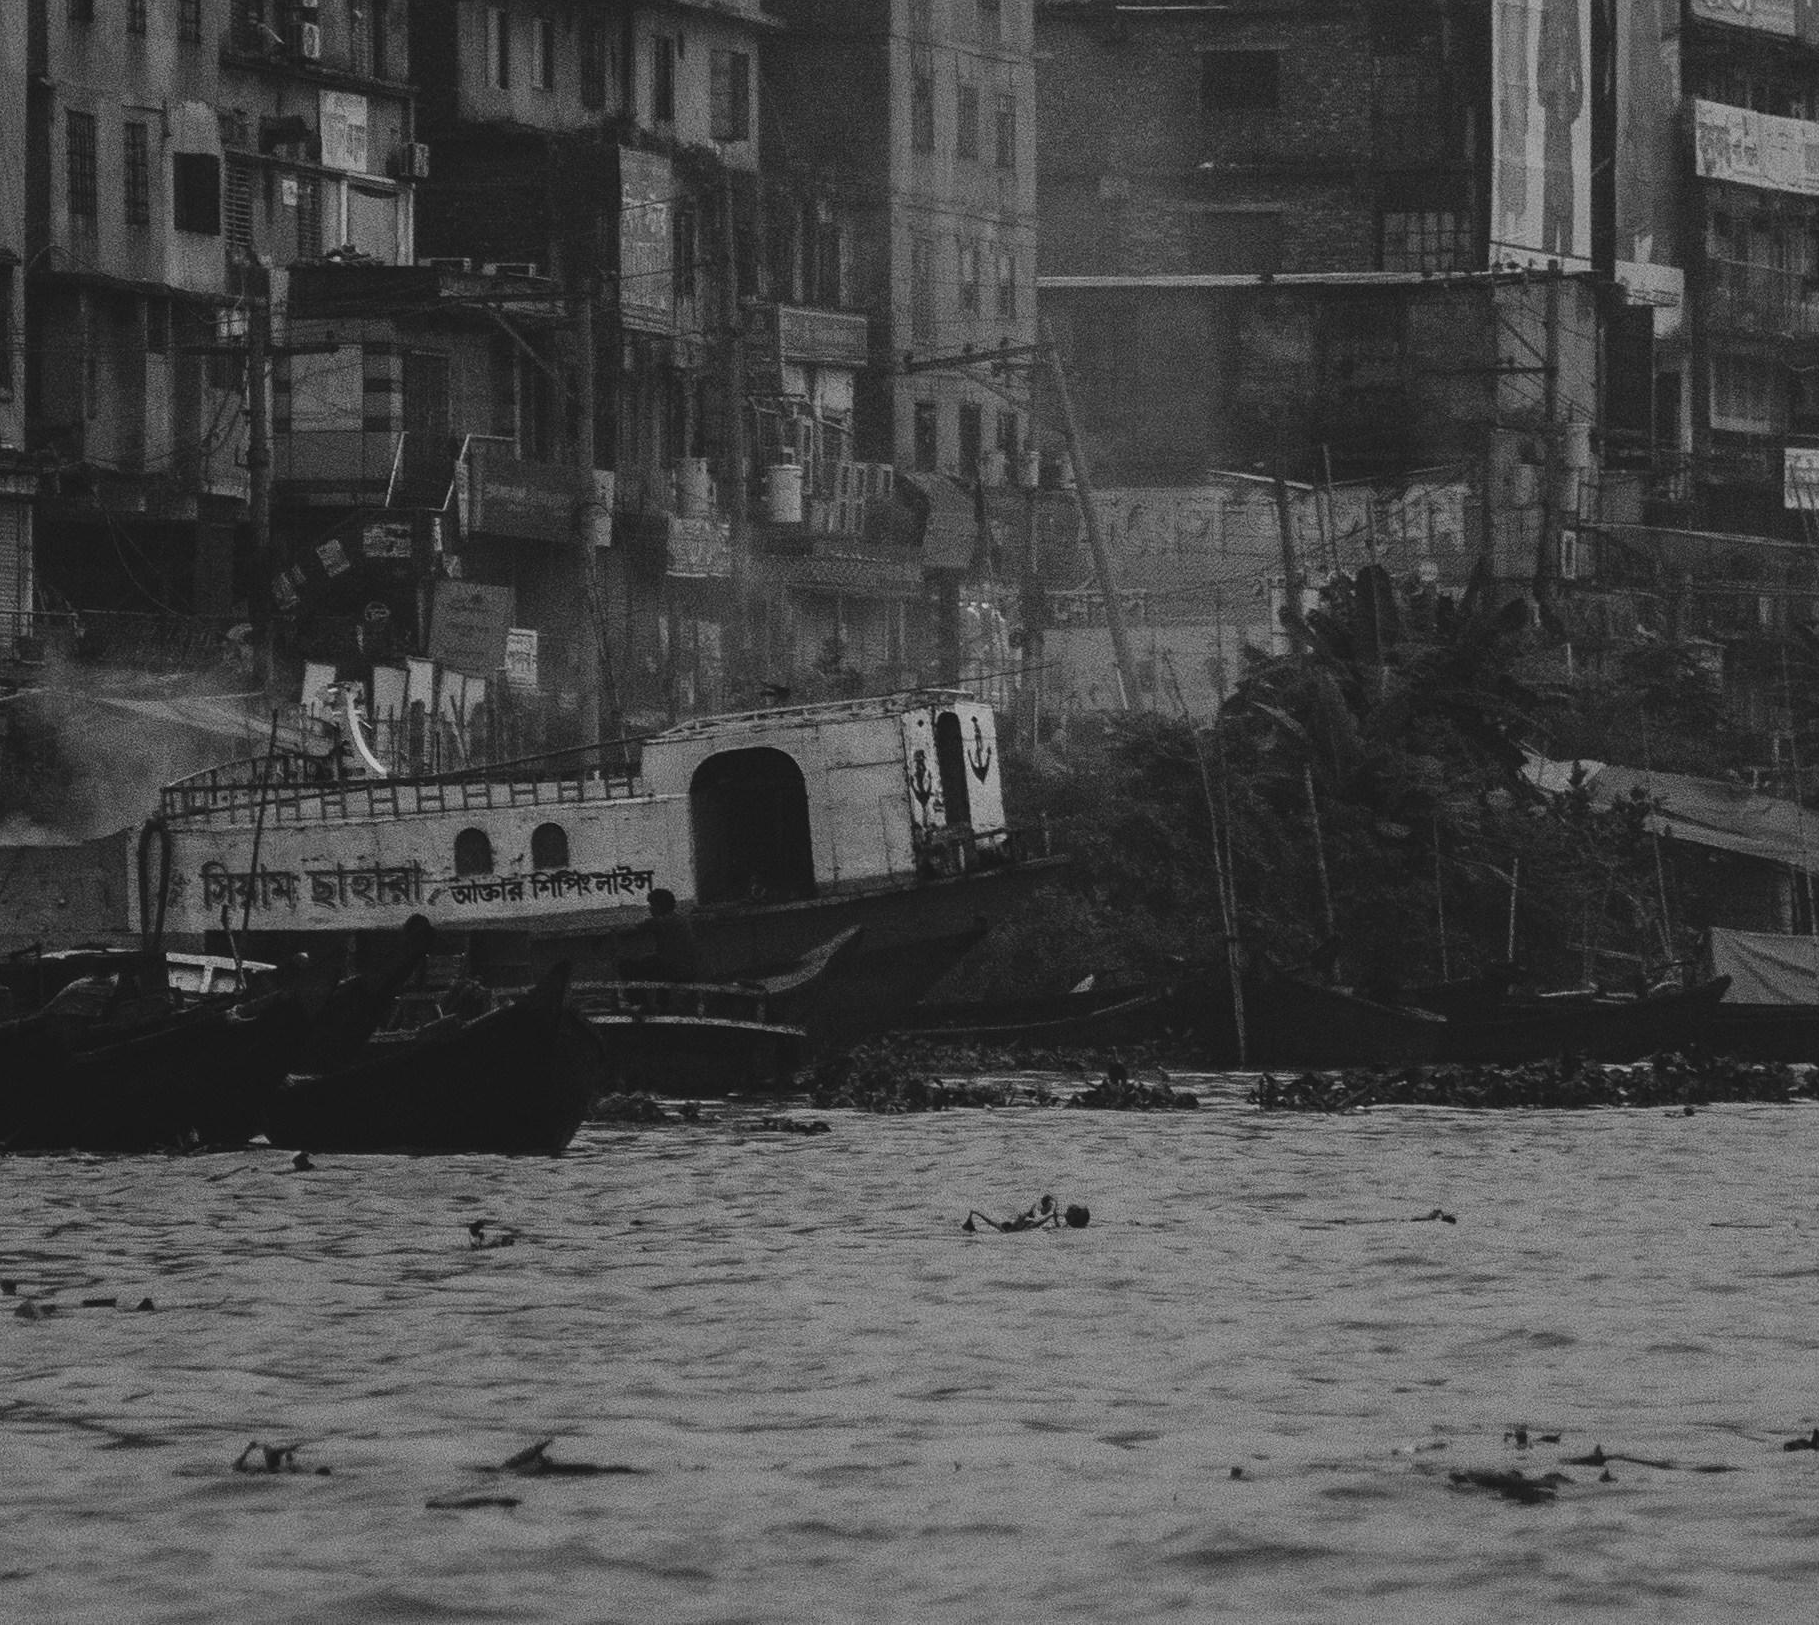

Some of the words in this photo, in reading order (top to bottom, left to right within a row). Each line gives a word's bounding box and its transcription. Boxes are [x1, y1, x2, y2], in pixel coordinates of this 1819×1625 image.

[450, 878, 524, 905] আক্তার
[531, 868, 591, 900] শিপিং
[591, 864, 655, 896] লাইন্স
